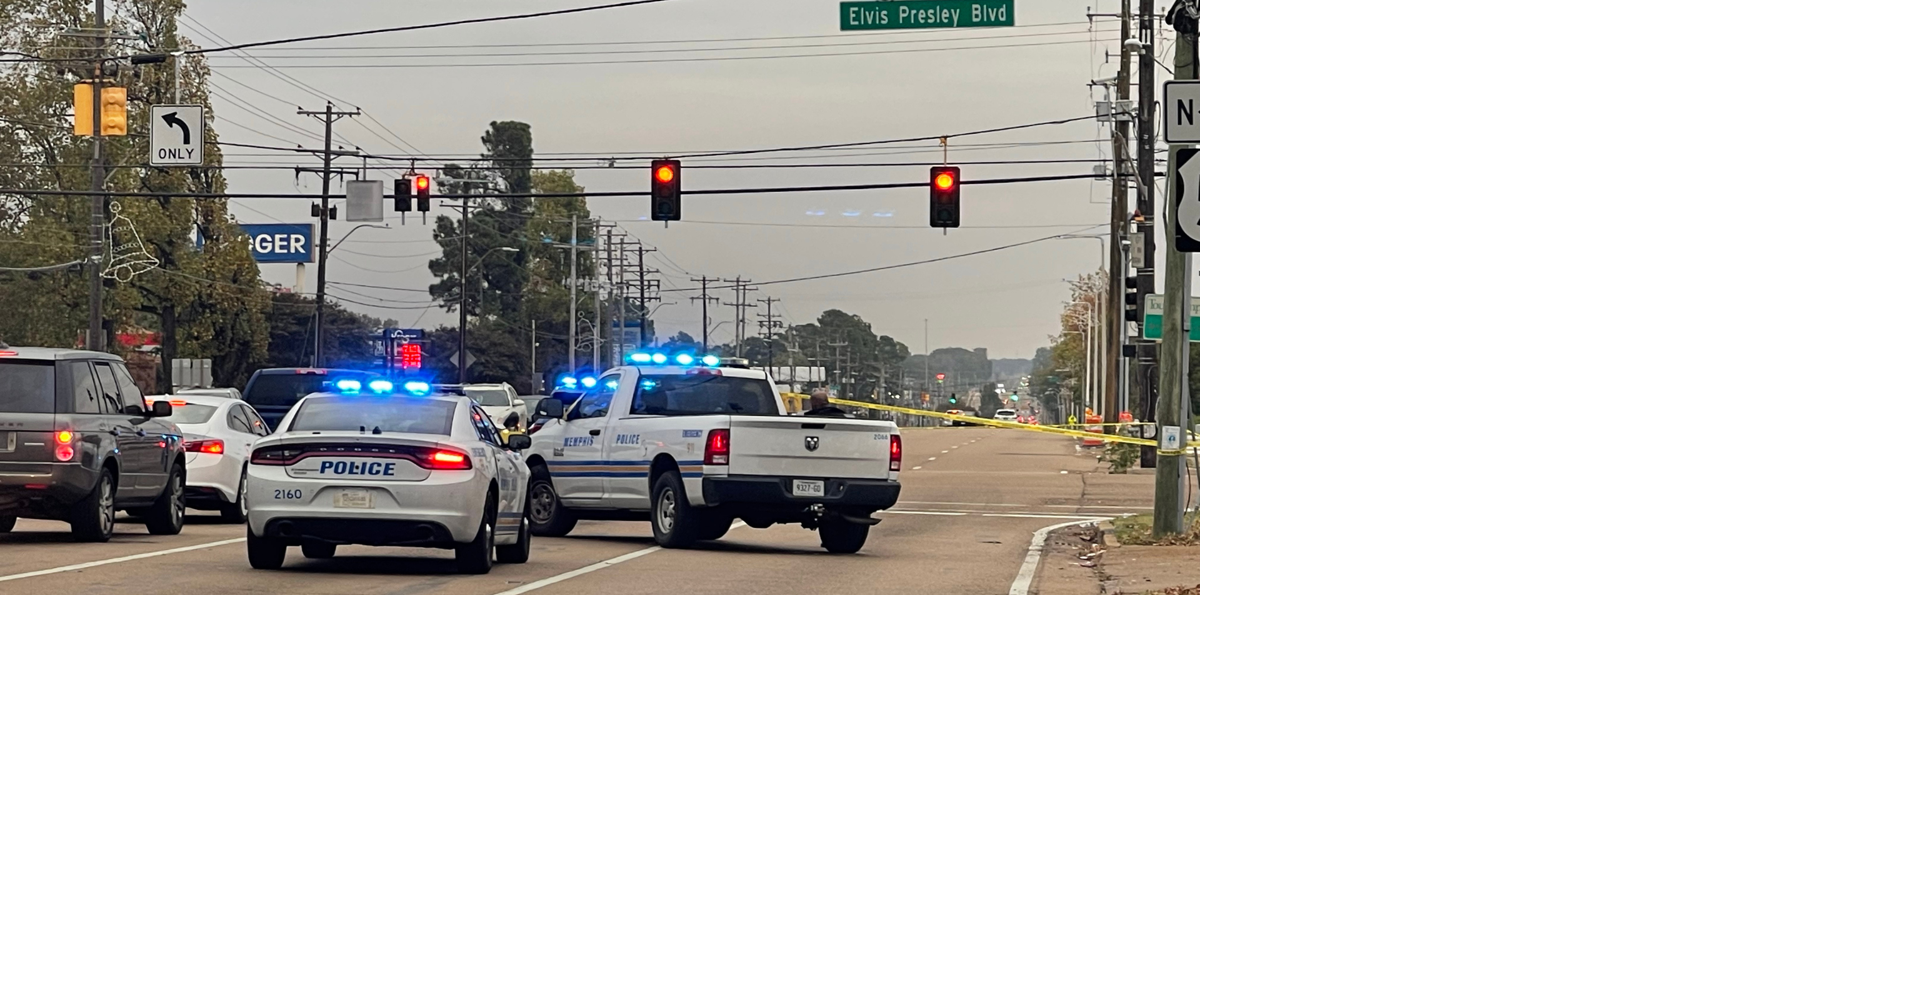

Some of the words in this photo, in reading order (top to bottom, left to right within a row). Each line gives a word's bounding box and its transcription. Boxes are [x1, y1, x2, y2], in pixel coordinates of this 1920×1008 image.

[849, 7, 889, 25] Elvis
[899, 5, 960, 27] Presley
[971, 4, 1007, 22] Blvd
[1177, 99, 1200, 126] N
[158, 148, 194, 159] ONLY
[248, 233, 306, 254] GER
[563, 436, 595, 447] MEMPHIS
[615, 434, 640, 445] POLICE
[319, 461, 396, 476] POLICE
[274, 489, 302, 500] 2160
